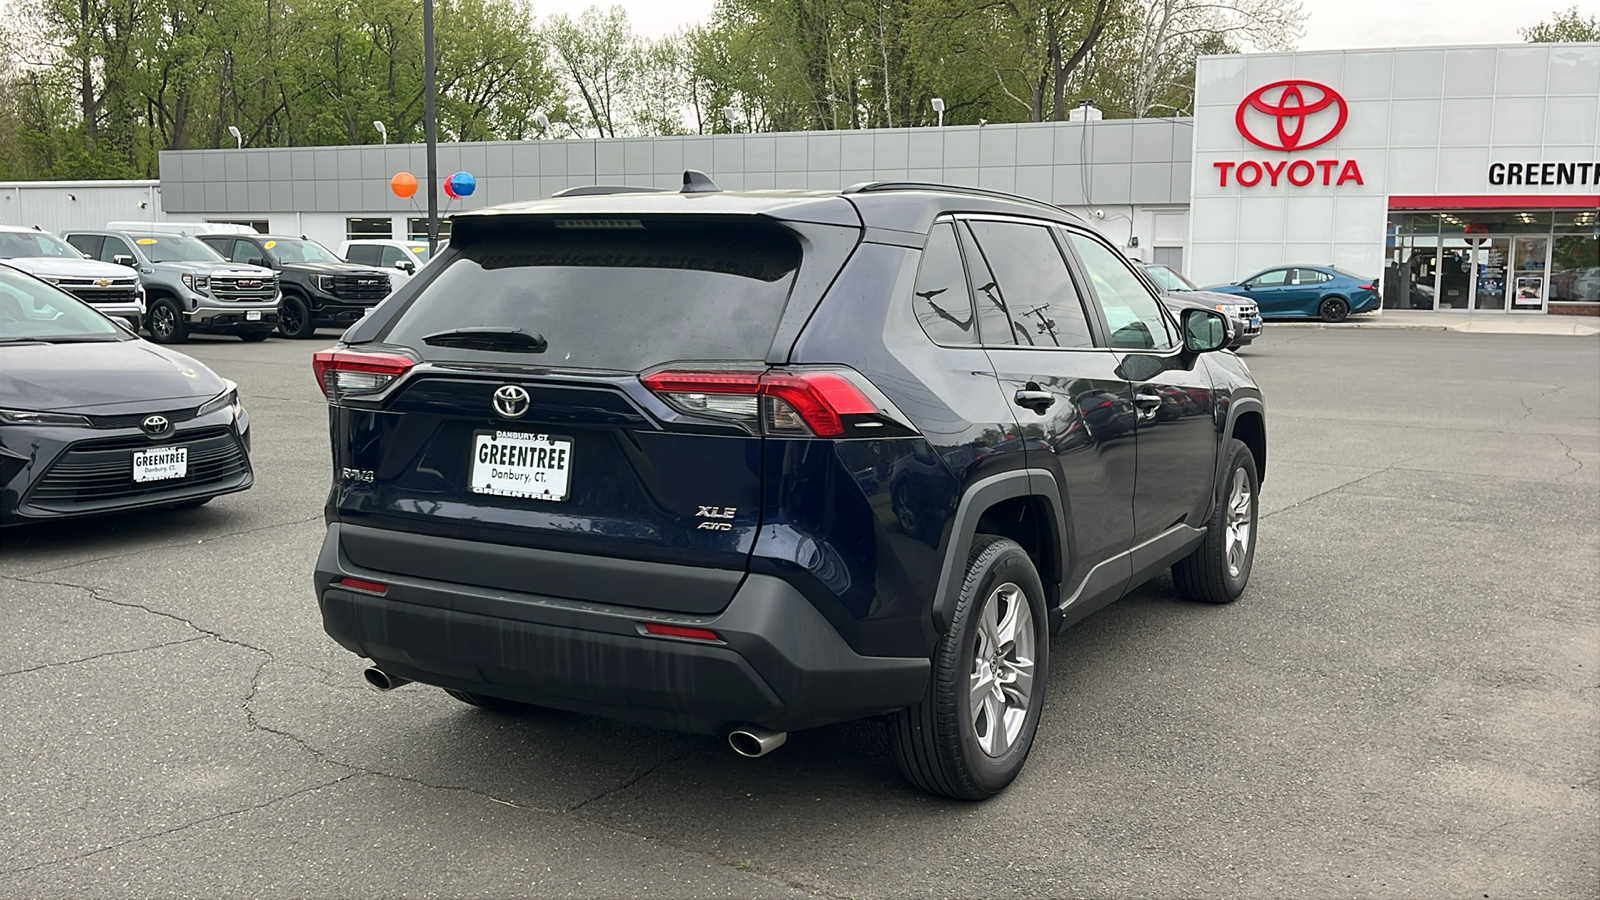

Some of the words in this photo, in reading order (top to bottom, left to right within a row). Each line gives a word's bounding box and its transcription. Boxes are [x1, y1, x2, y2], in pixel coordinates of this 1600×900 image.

[1213, 160, 1364, 187] TOYOTA
[136, 452, 185, 467] GREENTREE
[479, 443, 566, 470] GREENTREE
[492, 468, 531, 484] Danbury,
[534, 472, 546, 482] CT.
[472, 487, 562, 501] GREENTREE
[695, 505, 737, 519] XLE
[697, 521, 732, 531] AWD
